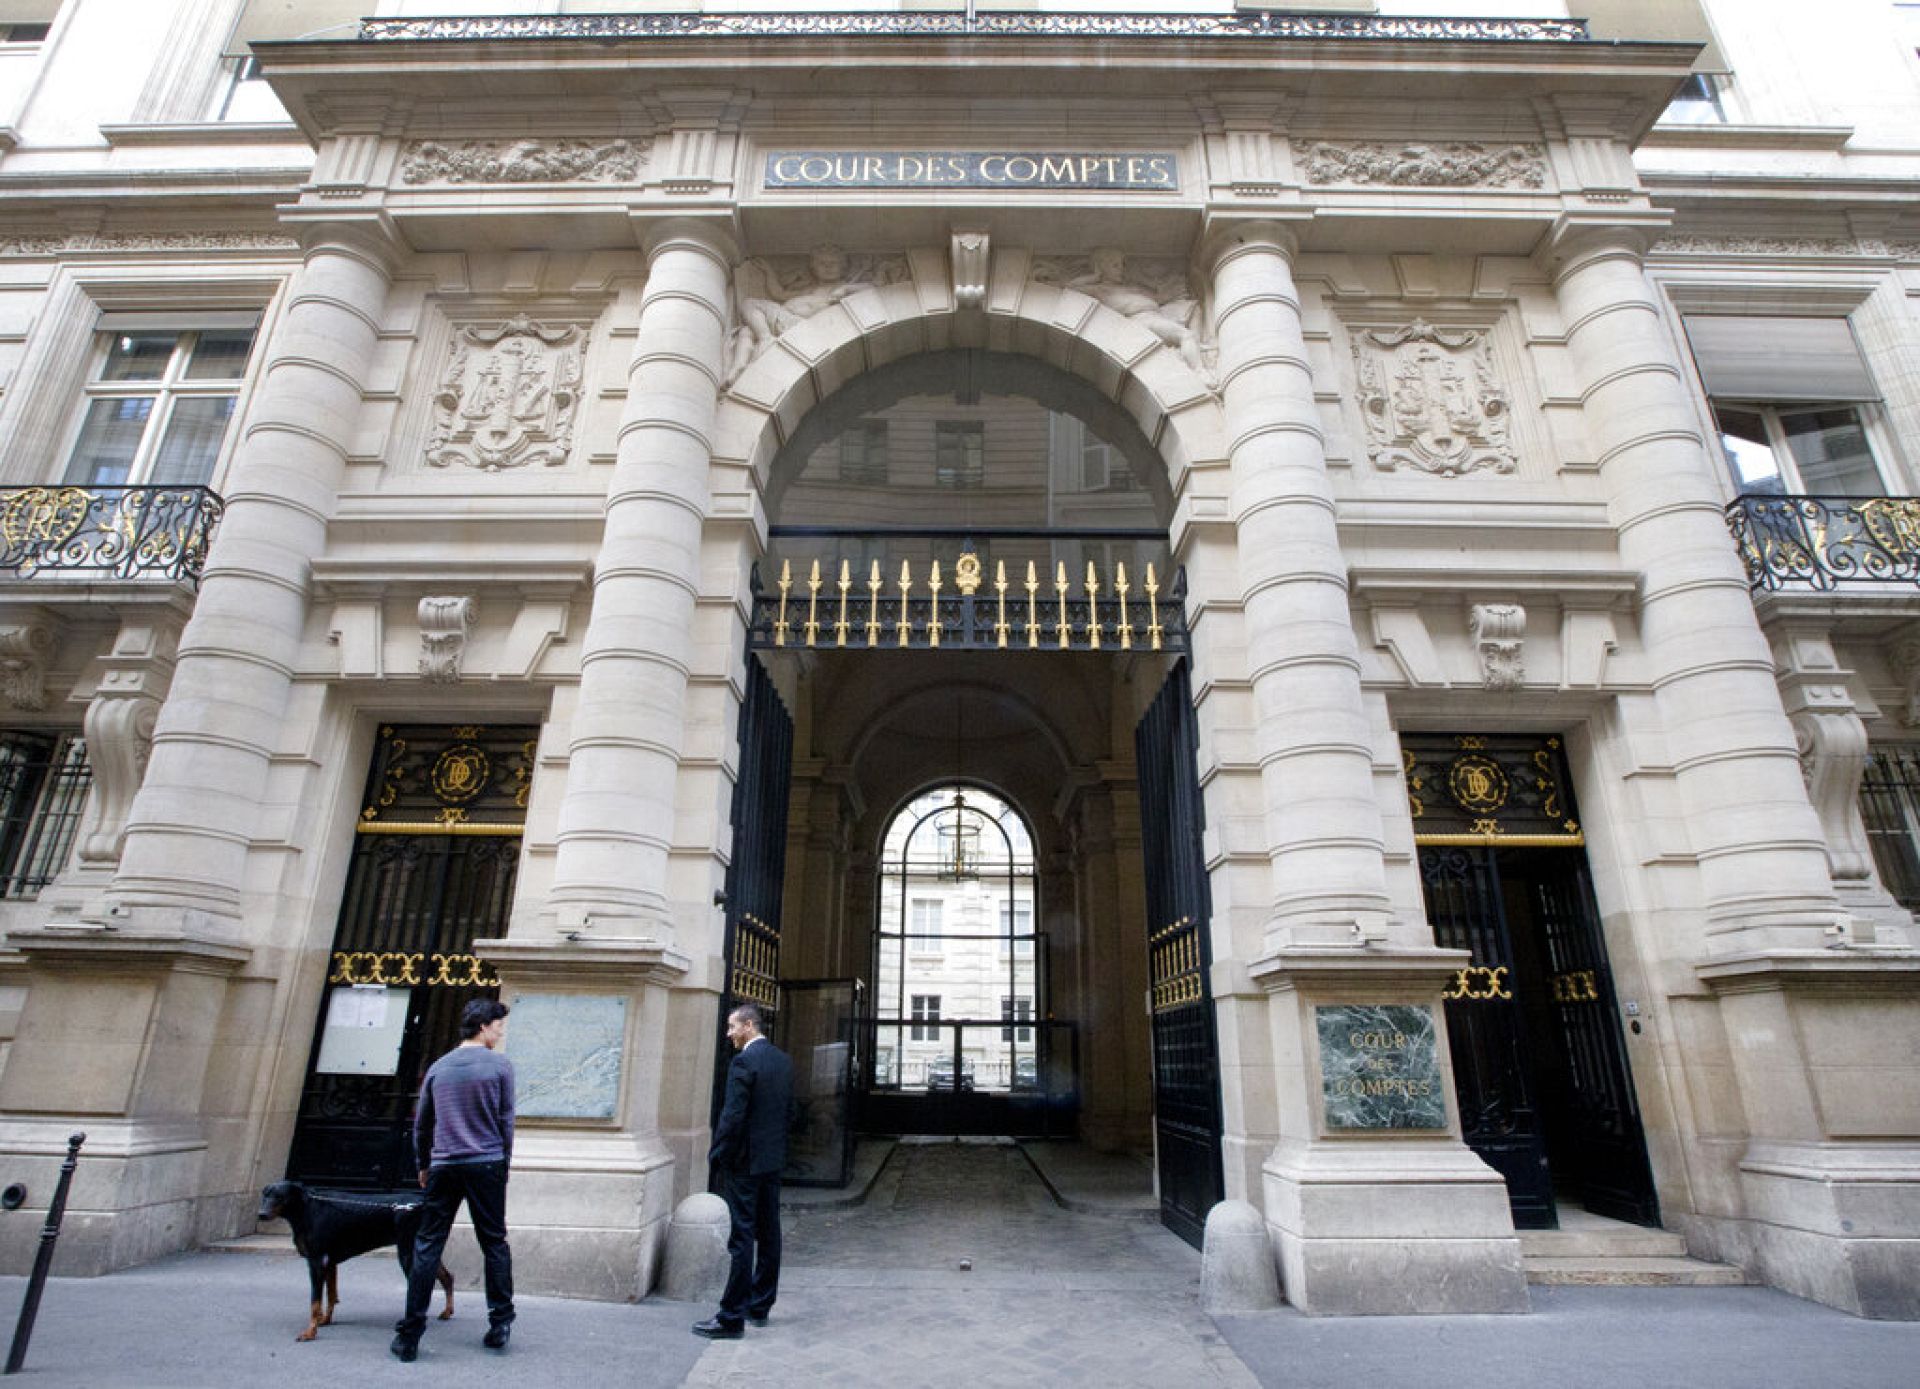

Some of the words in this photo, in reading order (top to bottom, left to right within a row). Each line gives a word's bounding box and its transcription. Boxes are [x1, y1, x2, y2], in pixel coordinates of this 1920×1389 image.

[774, 156, 886, 182] COUR
[897, 156, 967, 182] DES
[979, 156, 1169, 183] COMPTES
[1351, 1031, 1406, 1049] COUR
[1337, 1079, 1430, 1096] COMPTES
